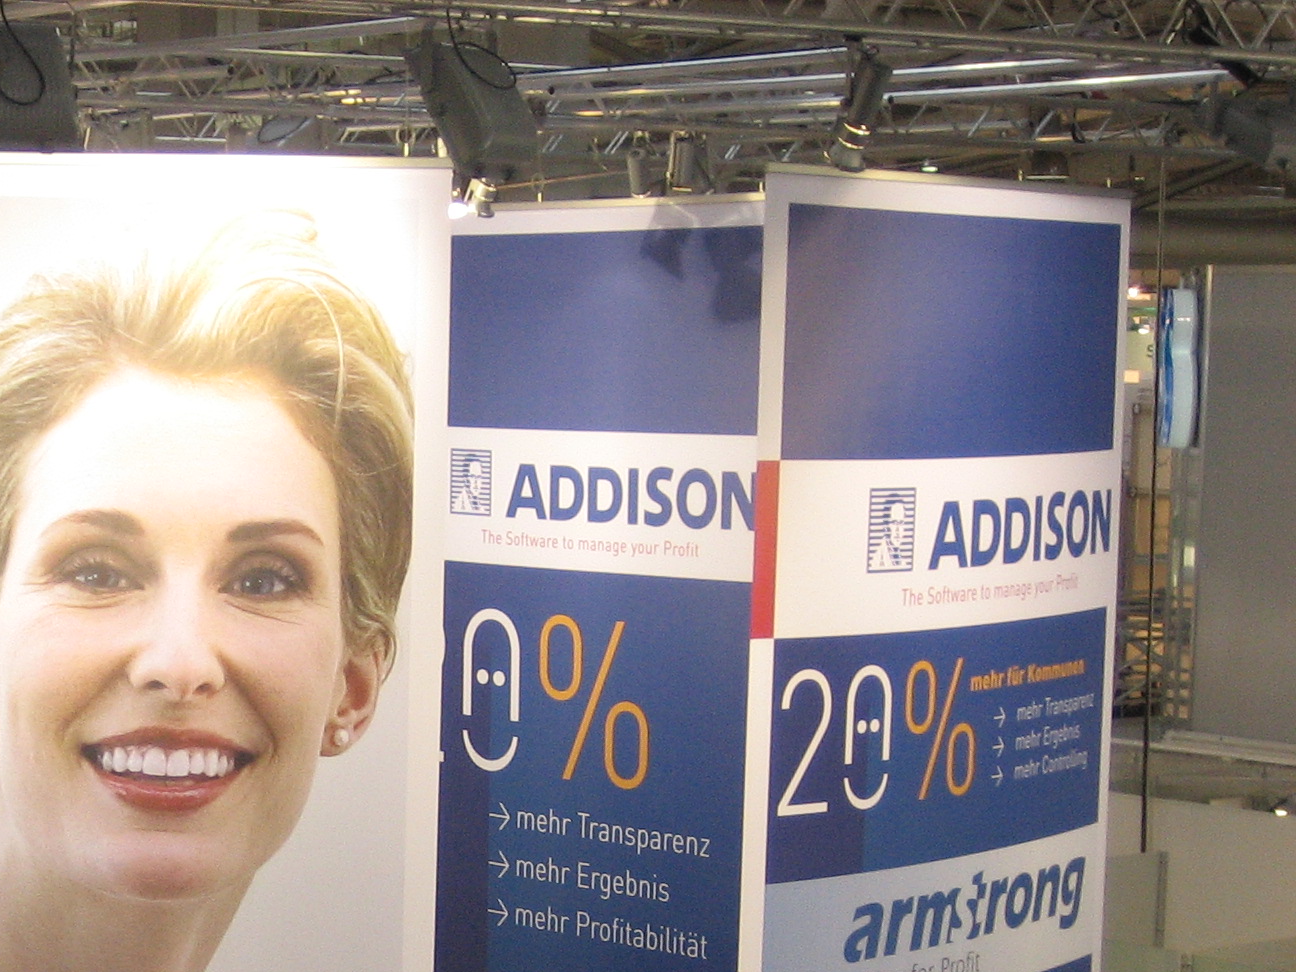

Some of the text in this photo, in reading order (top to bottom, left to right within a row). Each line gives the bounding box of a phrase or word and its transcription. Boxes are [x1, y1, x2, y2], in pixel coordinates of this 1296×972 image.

[505, 463, 755, 531] ADDISON
[481, 529, 700, 558] The Software to manage your Profit
[927, 488, 1112, 571] ADDISON
[901, 588, 923, 607] The
[927, 585, 978, 606] Software
[980, 584, 990, 600] to
[993, 582, 1033, 602] manage
[1034, 579, 1054, 599] your
[970, 669, 1005, 692] mehr
[1007, 664, 1025, 687] für
[1016, 700, 1044, 721] mehr
[1015, 729, 1042, 751] mehr
[1013, 759, 1041, 780] mehr
[516, 808, 711, 858] mehr Transparenz
[515, 857, 671, 903] mehr Ergebnis
[843, 856, 1087, 965] armstrong
[514, 906, 709, 960] mehr Profitabilität
